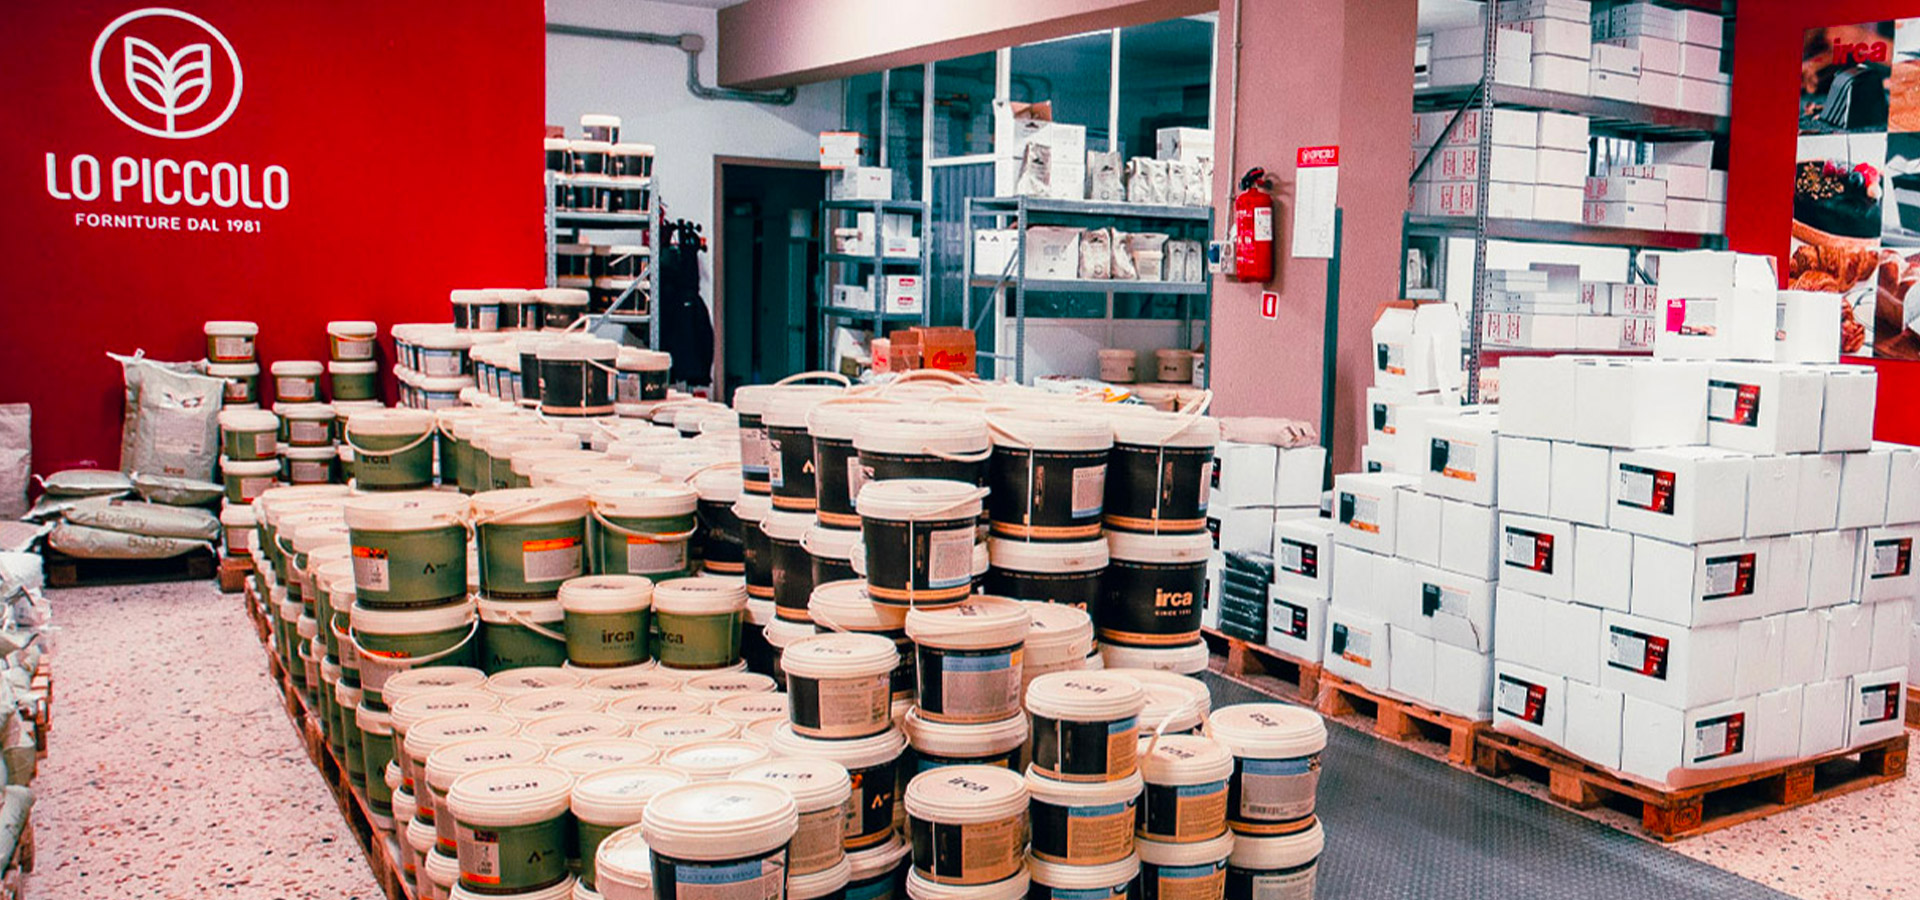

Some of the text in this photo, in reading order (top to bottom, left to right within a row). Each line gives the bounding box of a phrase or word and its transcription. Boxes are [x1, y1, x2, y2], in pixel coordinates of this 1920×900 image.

[1832, 37, 1887, 65] irca
[46, 152, 290, 210] LO PICCOLO
[75, 213, 261, 233] FORNITURE DAL 1981
[1155, 588, 1193, 607] irca
[602, 630, 635, 644] irca
[660, 630, 685, 645] rca
